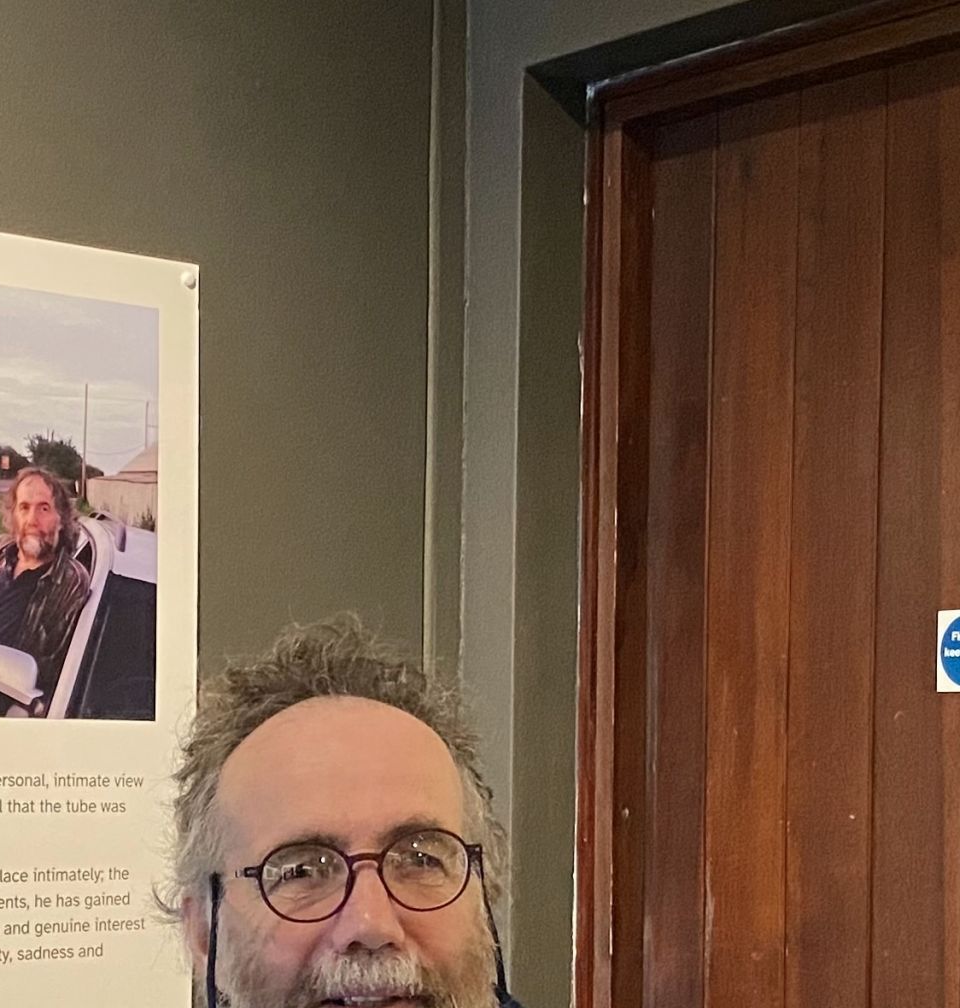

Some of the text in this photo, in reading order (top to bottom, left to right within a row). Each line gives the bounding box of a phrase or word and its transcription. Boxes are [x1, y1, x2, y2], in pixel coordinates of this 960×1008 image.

[53, 772, 111, 788] intimate
[114, 772, 144, 788] view
[34, 893, 52, 908] he
[55, 893, 80, 907] has
[84, 891, 130, 910] gained
[3, 919, 30, 936] and
[34, 917, 90, 938] genuine
[94, 916, 145, 932] interest
